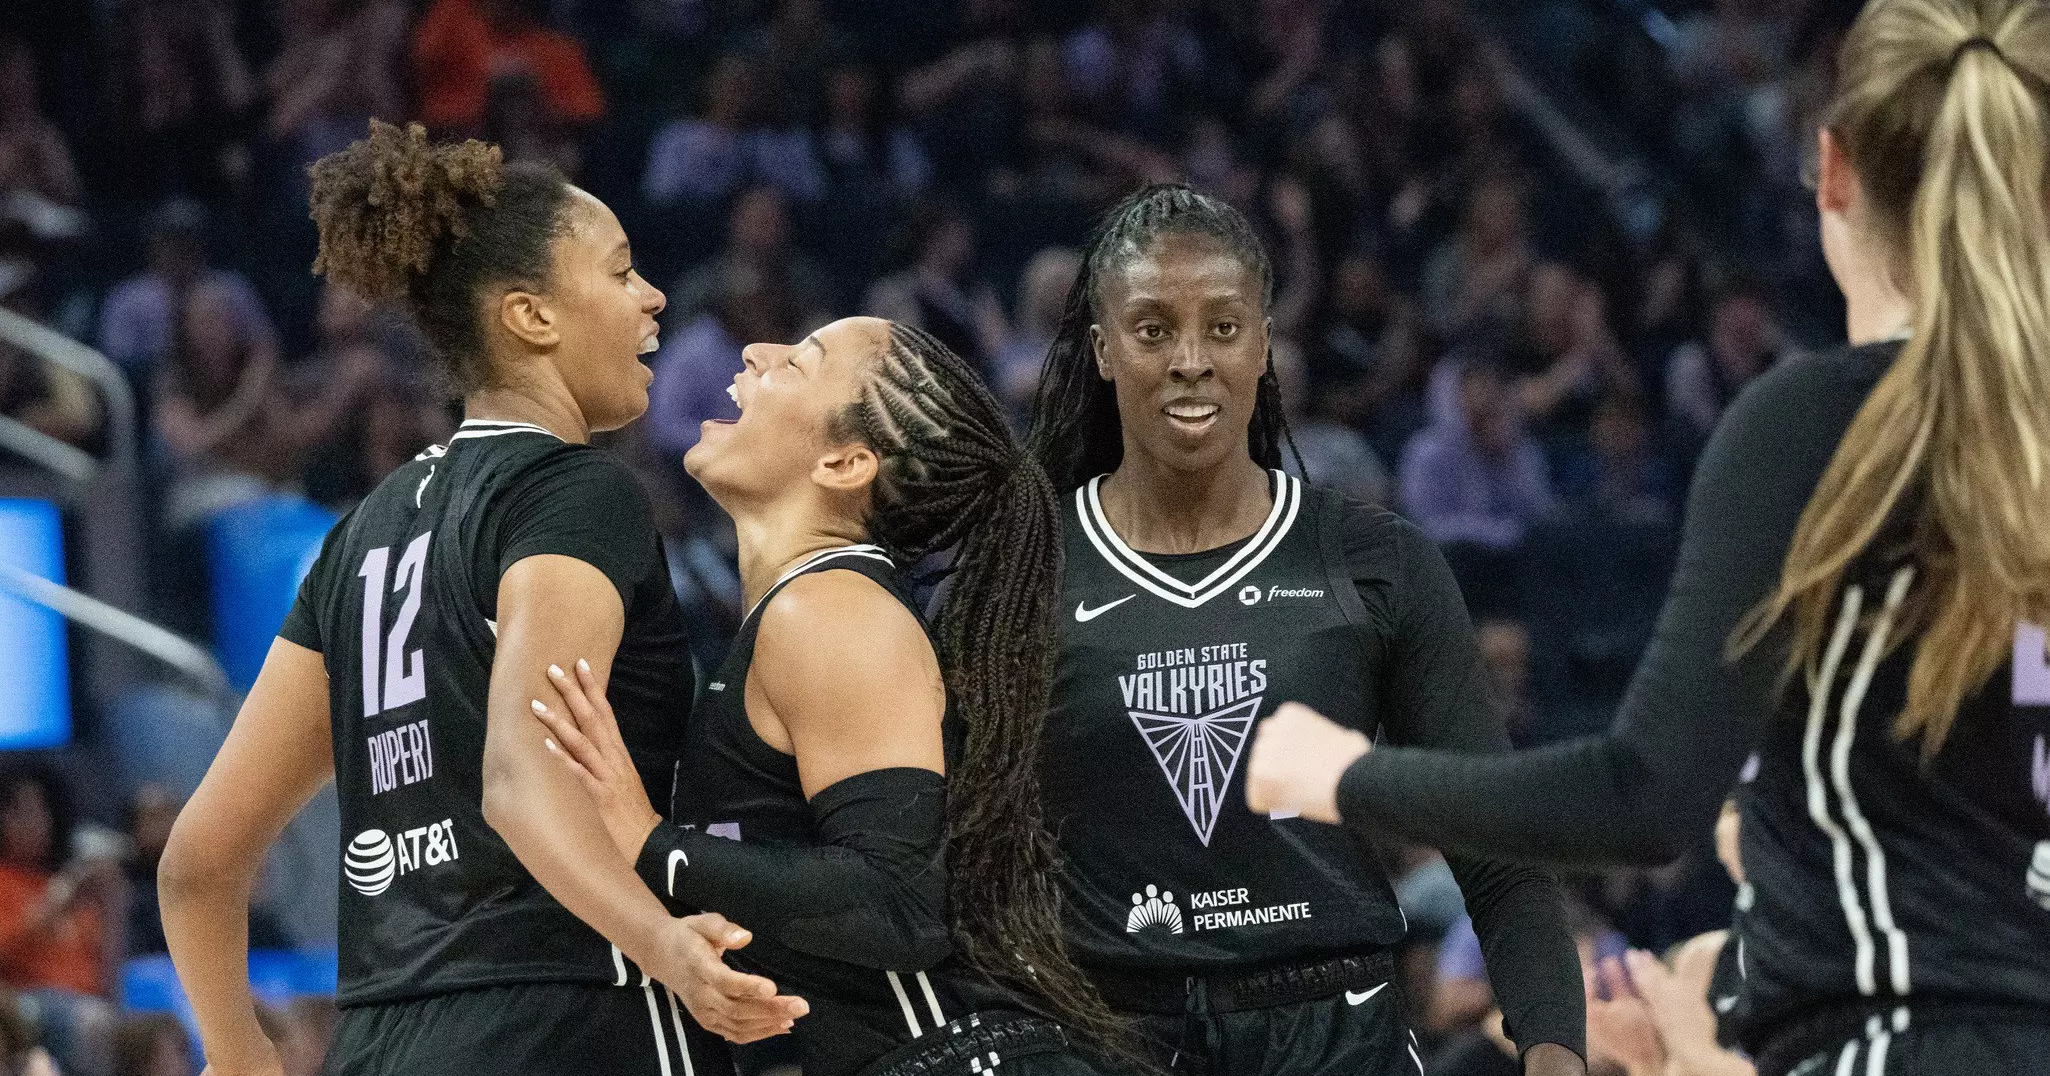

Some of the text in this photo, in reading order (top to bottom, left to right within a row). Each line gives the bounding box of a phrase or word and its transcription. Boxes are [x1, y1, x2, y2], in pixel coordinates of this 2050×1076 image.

[1266, 584, 1325, 602] freedom
[357, 528, 432, 718] 12
[1137, 642, 1248, 671] GOLDEN STATE
[1118, 659, 1267, 715] VALKYRIES
[367, 719, 433, 796] RUPERT
[397, 818, 459, 876] AT&T
[1190, 887, 1250, 910] KAISER
[1193, 902, 1312, 931] PERMANENTE
